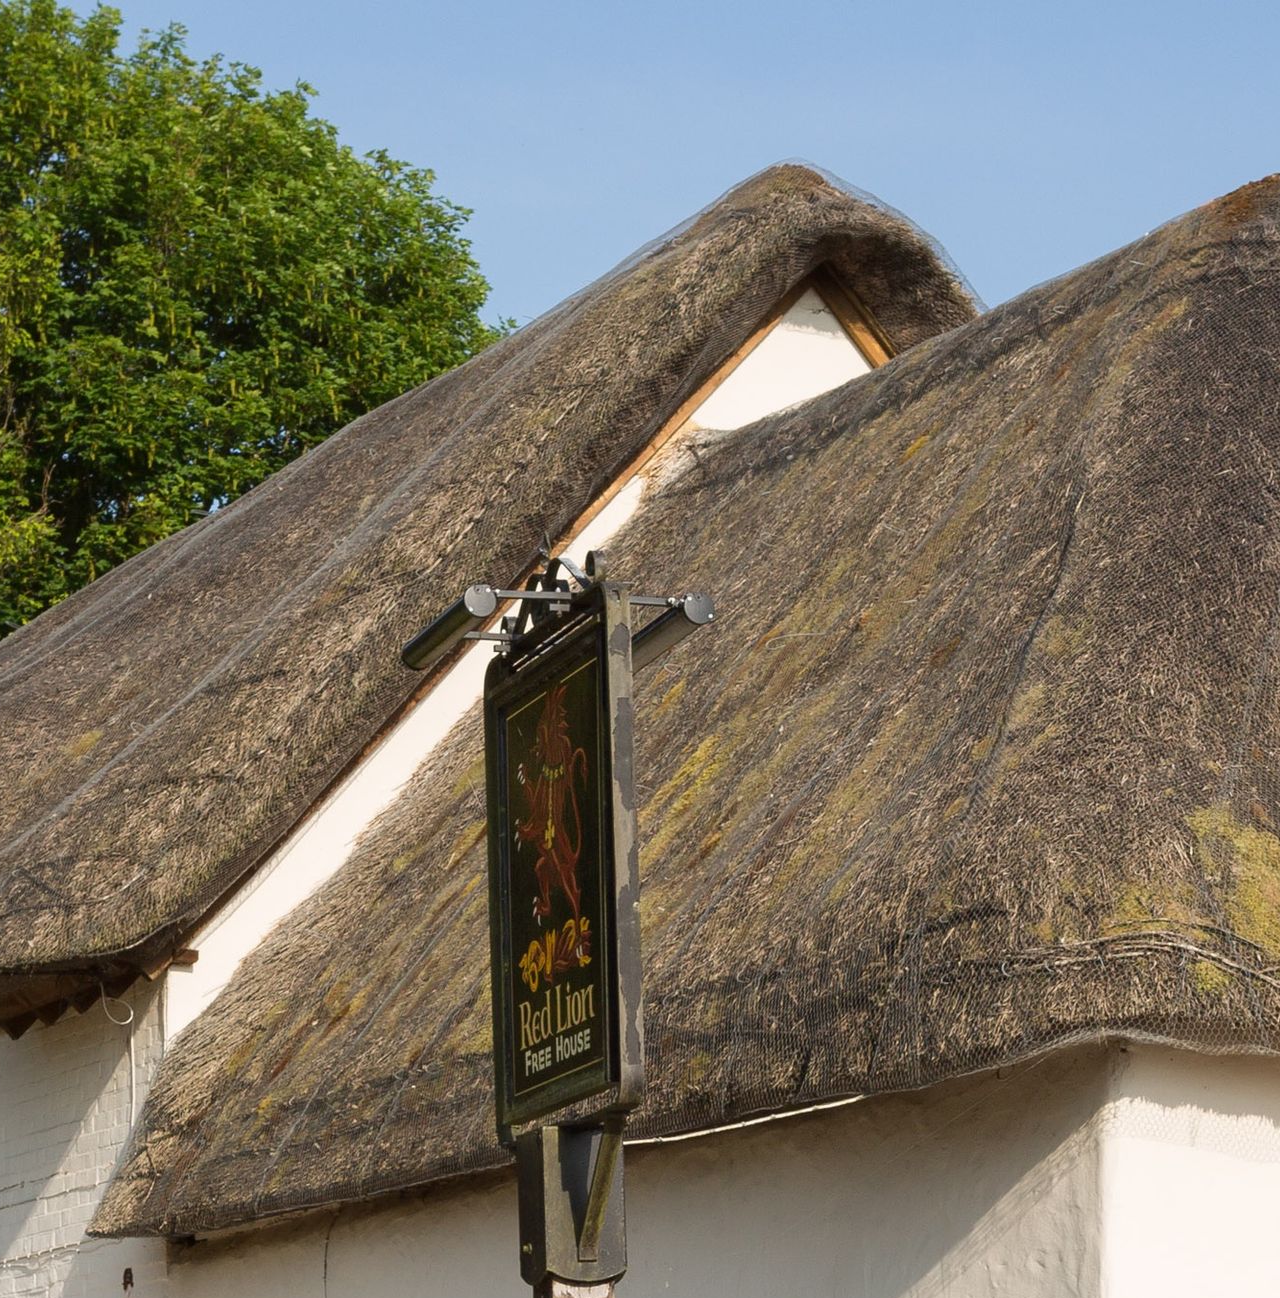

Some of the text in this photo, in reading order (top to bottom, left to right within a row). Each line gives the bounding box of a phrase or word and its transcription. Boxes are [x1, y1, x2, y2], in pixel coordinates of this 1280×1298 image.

[519, 983, 596, 1051] Red Lion
[525, 1028, 591, 1078] FREE HOUSE
